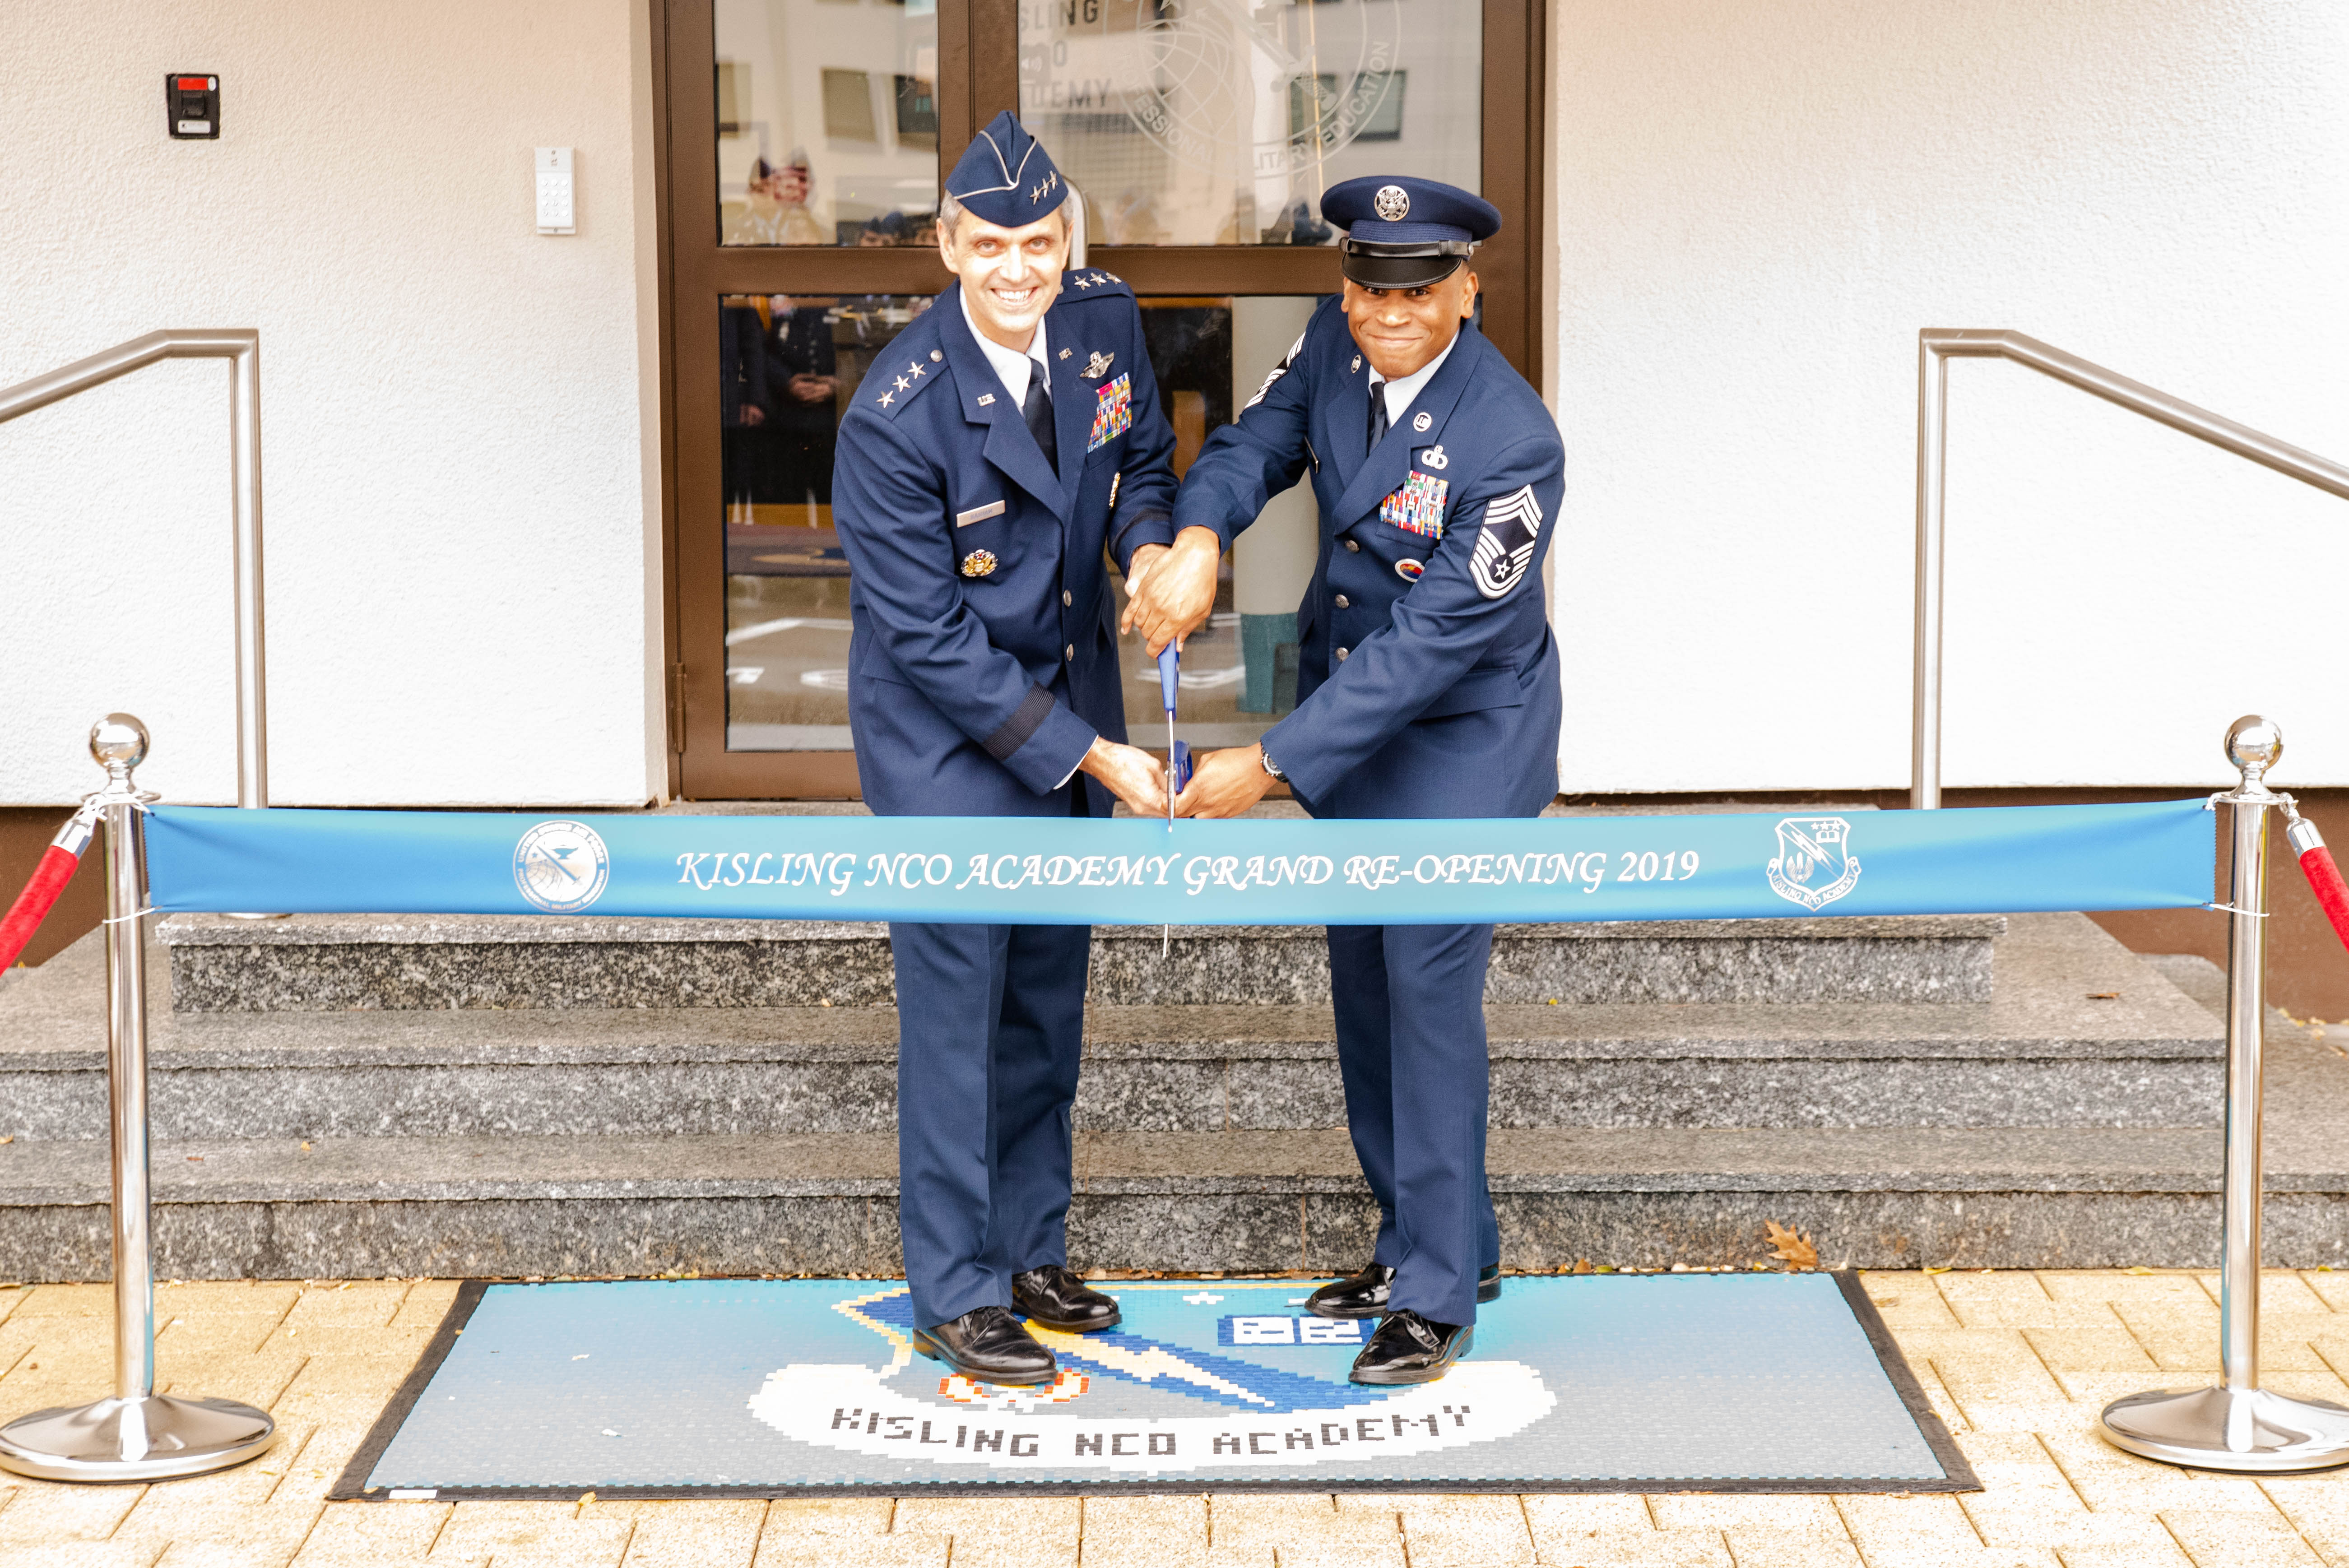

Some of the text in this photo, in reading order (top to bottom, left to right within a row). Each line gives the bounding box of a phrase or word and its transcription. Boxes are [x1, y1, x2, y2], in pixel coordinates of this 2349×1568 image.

[1320, 41, 1390, 148] EDUCATION
[676, 850, 1699, 896] KISLING NCO ACADEMY GRAND RE-OPENING 2019
[831, 1405, 1471, 1457] KISLING NCO ACADEMY
